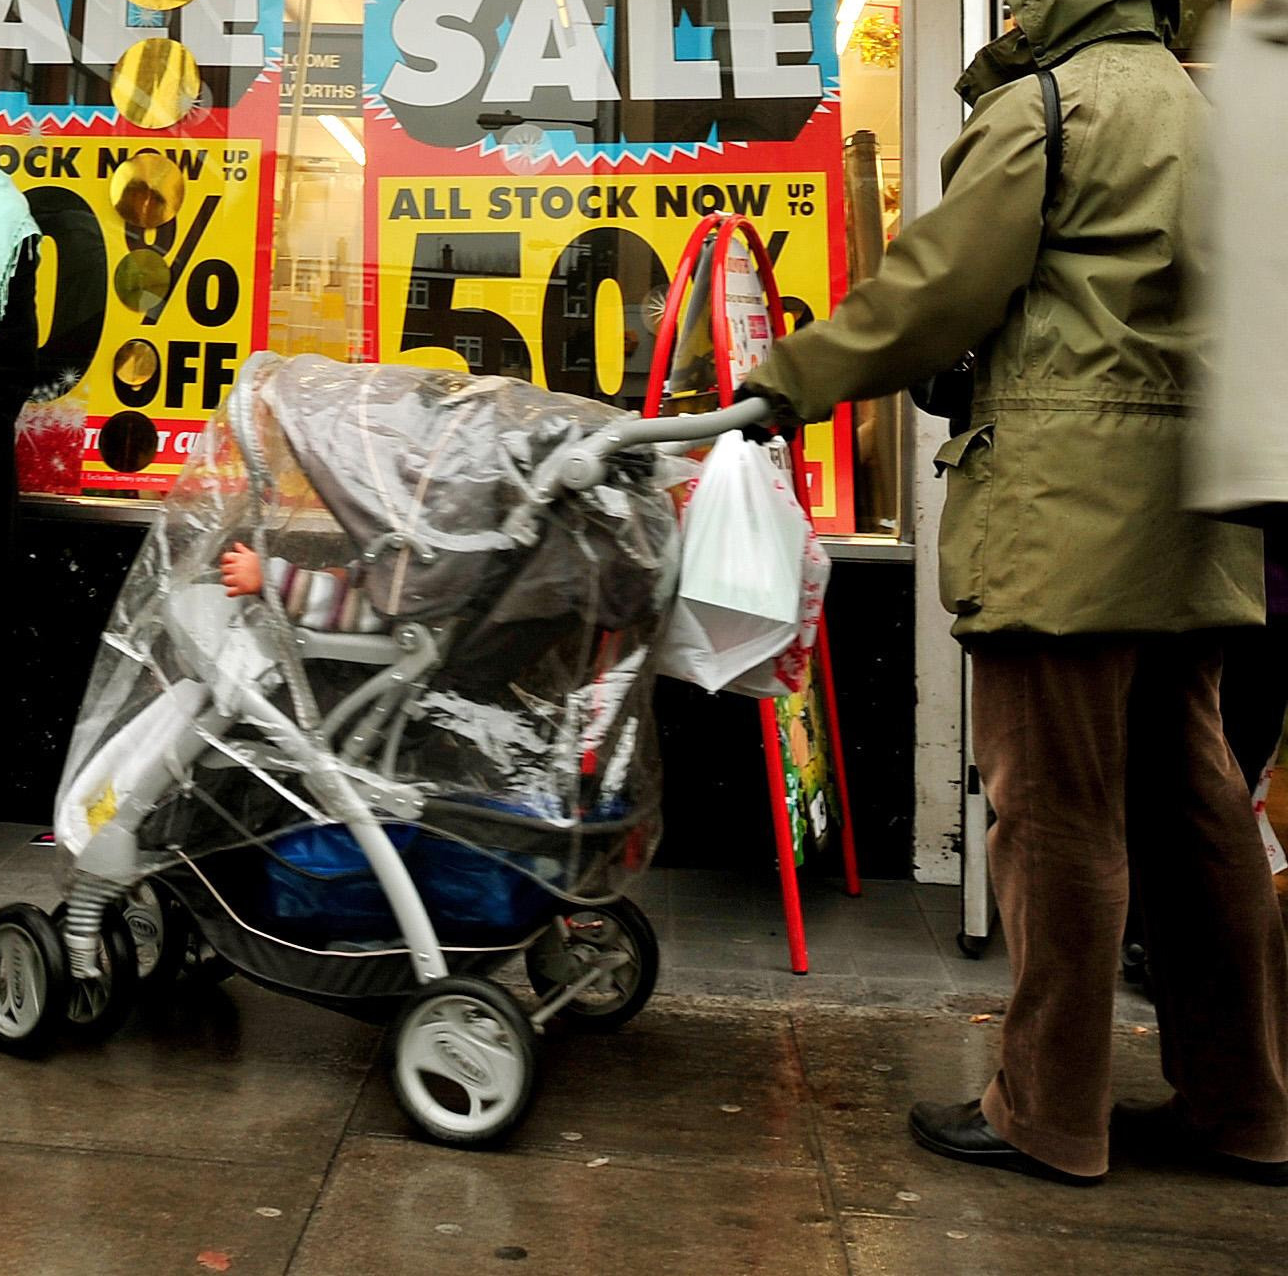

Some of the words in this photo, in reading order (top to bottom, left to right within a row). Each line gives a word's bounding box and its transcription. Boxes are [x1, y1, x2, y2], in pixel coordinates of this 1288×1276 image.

[283, 53, 342, 68] LCOME
[97, 147, 208, 181] NW
[223, 149, 249, 164] UP
[222, 167, 248, 181] TO
[787, 183, 815, 199] UP
[389, 187, 471, 220] ALL
[488, 184, 637, 220] STOCK
[656, 183, 771, 218] NOW
[788, 201, 815, 216] TO
[113, 338, 238, 409] OFF
